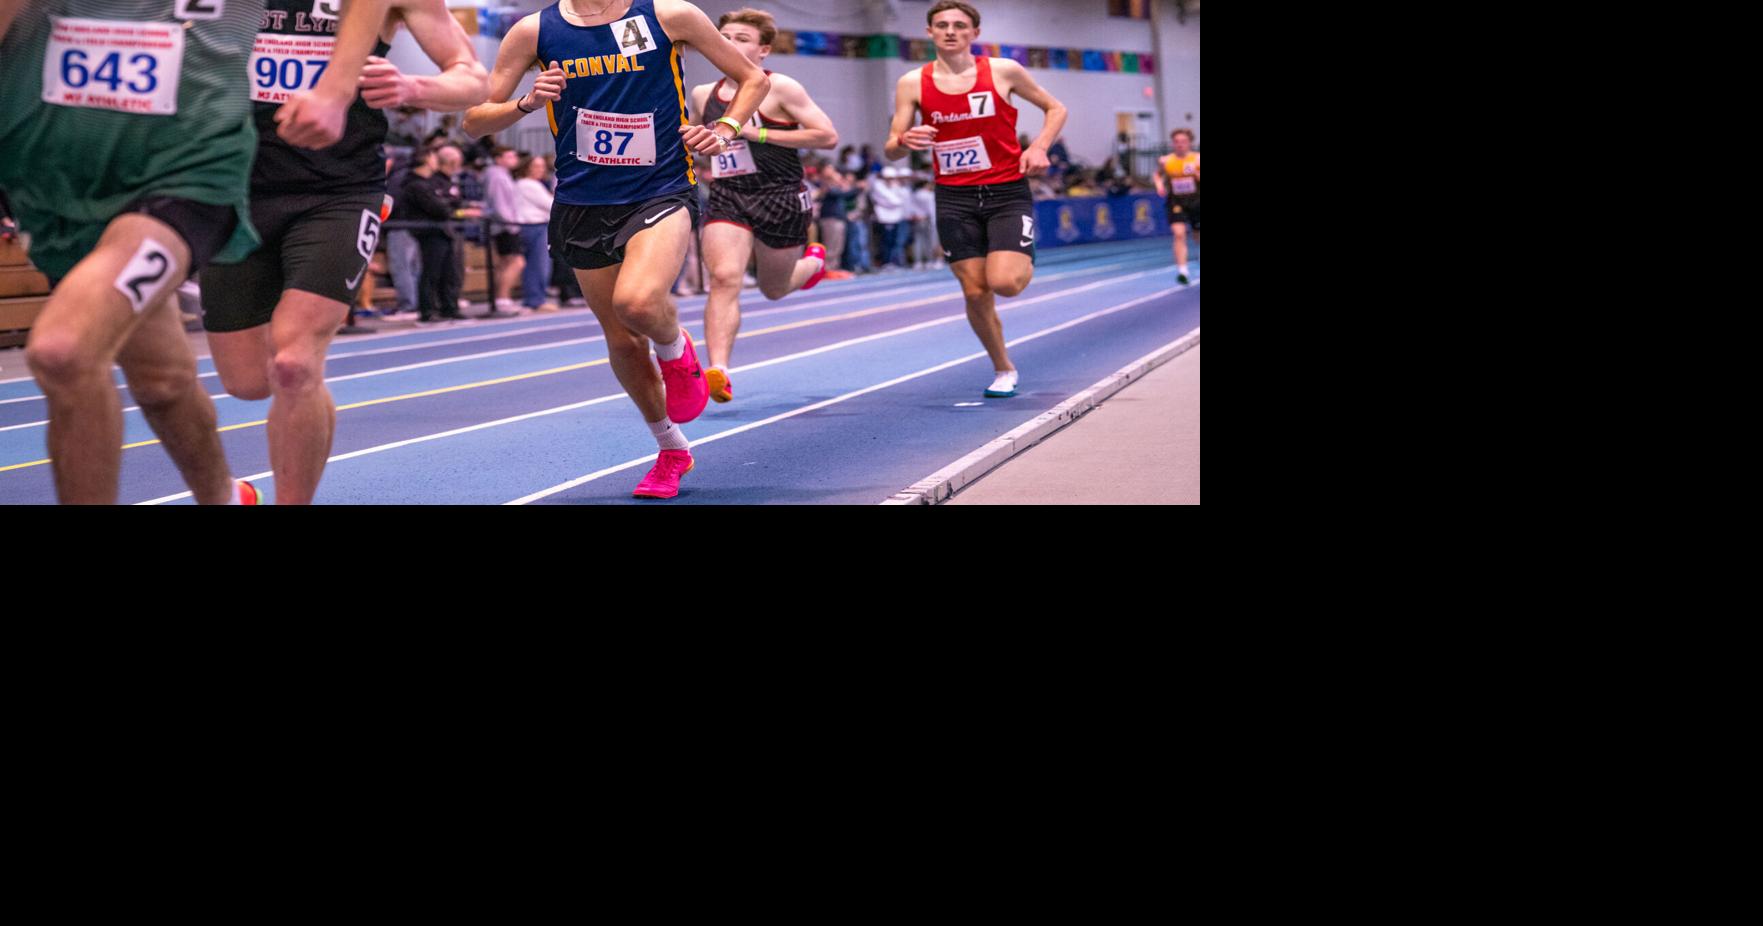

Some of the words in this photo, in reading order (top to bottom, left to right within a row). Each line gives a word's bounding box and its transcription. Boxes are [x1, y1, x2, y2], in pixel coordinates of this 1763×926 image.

[621, 19, 648, 50] 4
[60, 49, 157, 93] 643
[255, 57, 331, 90] 907
[562, 54, 645, 78] CONVAL
[972, 94, 988, 115] 7
[593, 114, 615, 122] ENGLAND
[594, 130, 634, 155] 87
[718, 153, 737, 170] 91
[940, 149, 981, 168] 722
[361, 217, 379, 253] 5
[127, 251, 168, 301] 2
